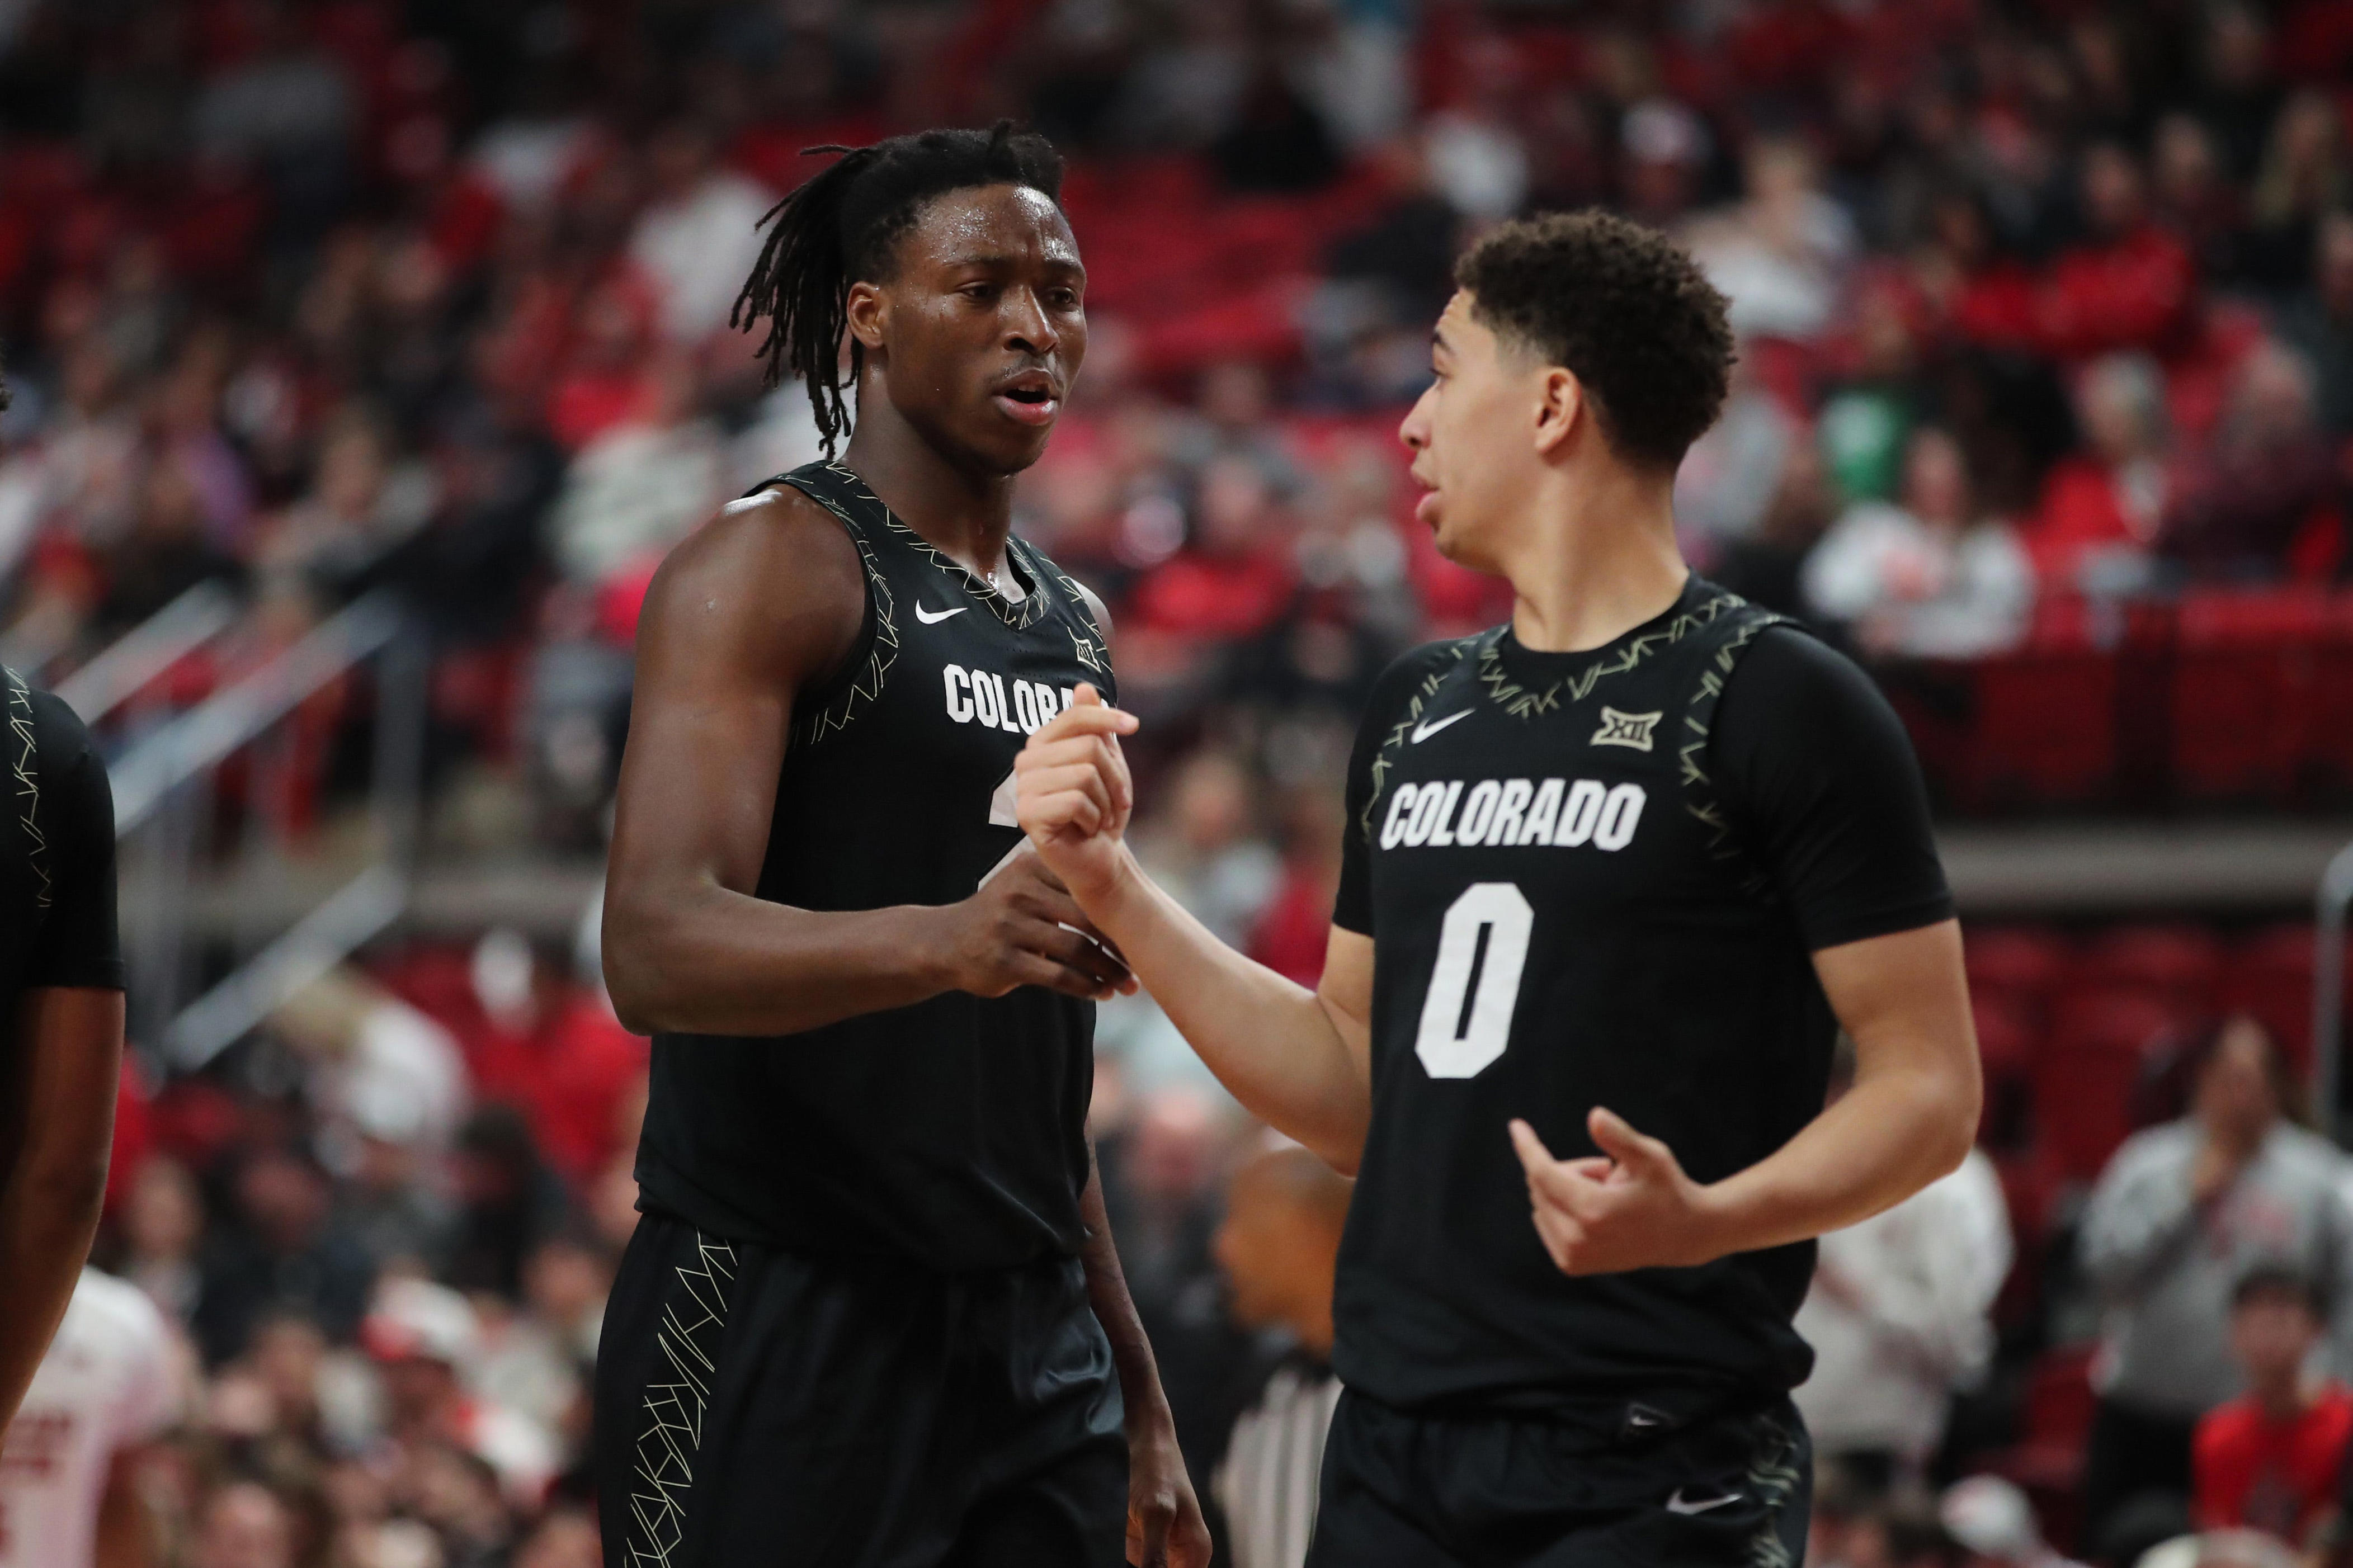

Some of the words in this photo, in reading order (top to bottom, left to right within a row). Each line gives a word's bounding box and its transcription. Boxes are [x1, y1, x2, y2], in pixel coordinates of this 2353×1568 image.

[943, 663, 1110, 736] COLOR
[1379, 777, 1647, 852] COLORADO
[1414, 882, 1534, 1079] 0
